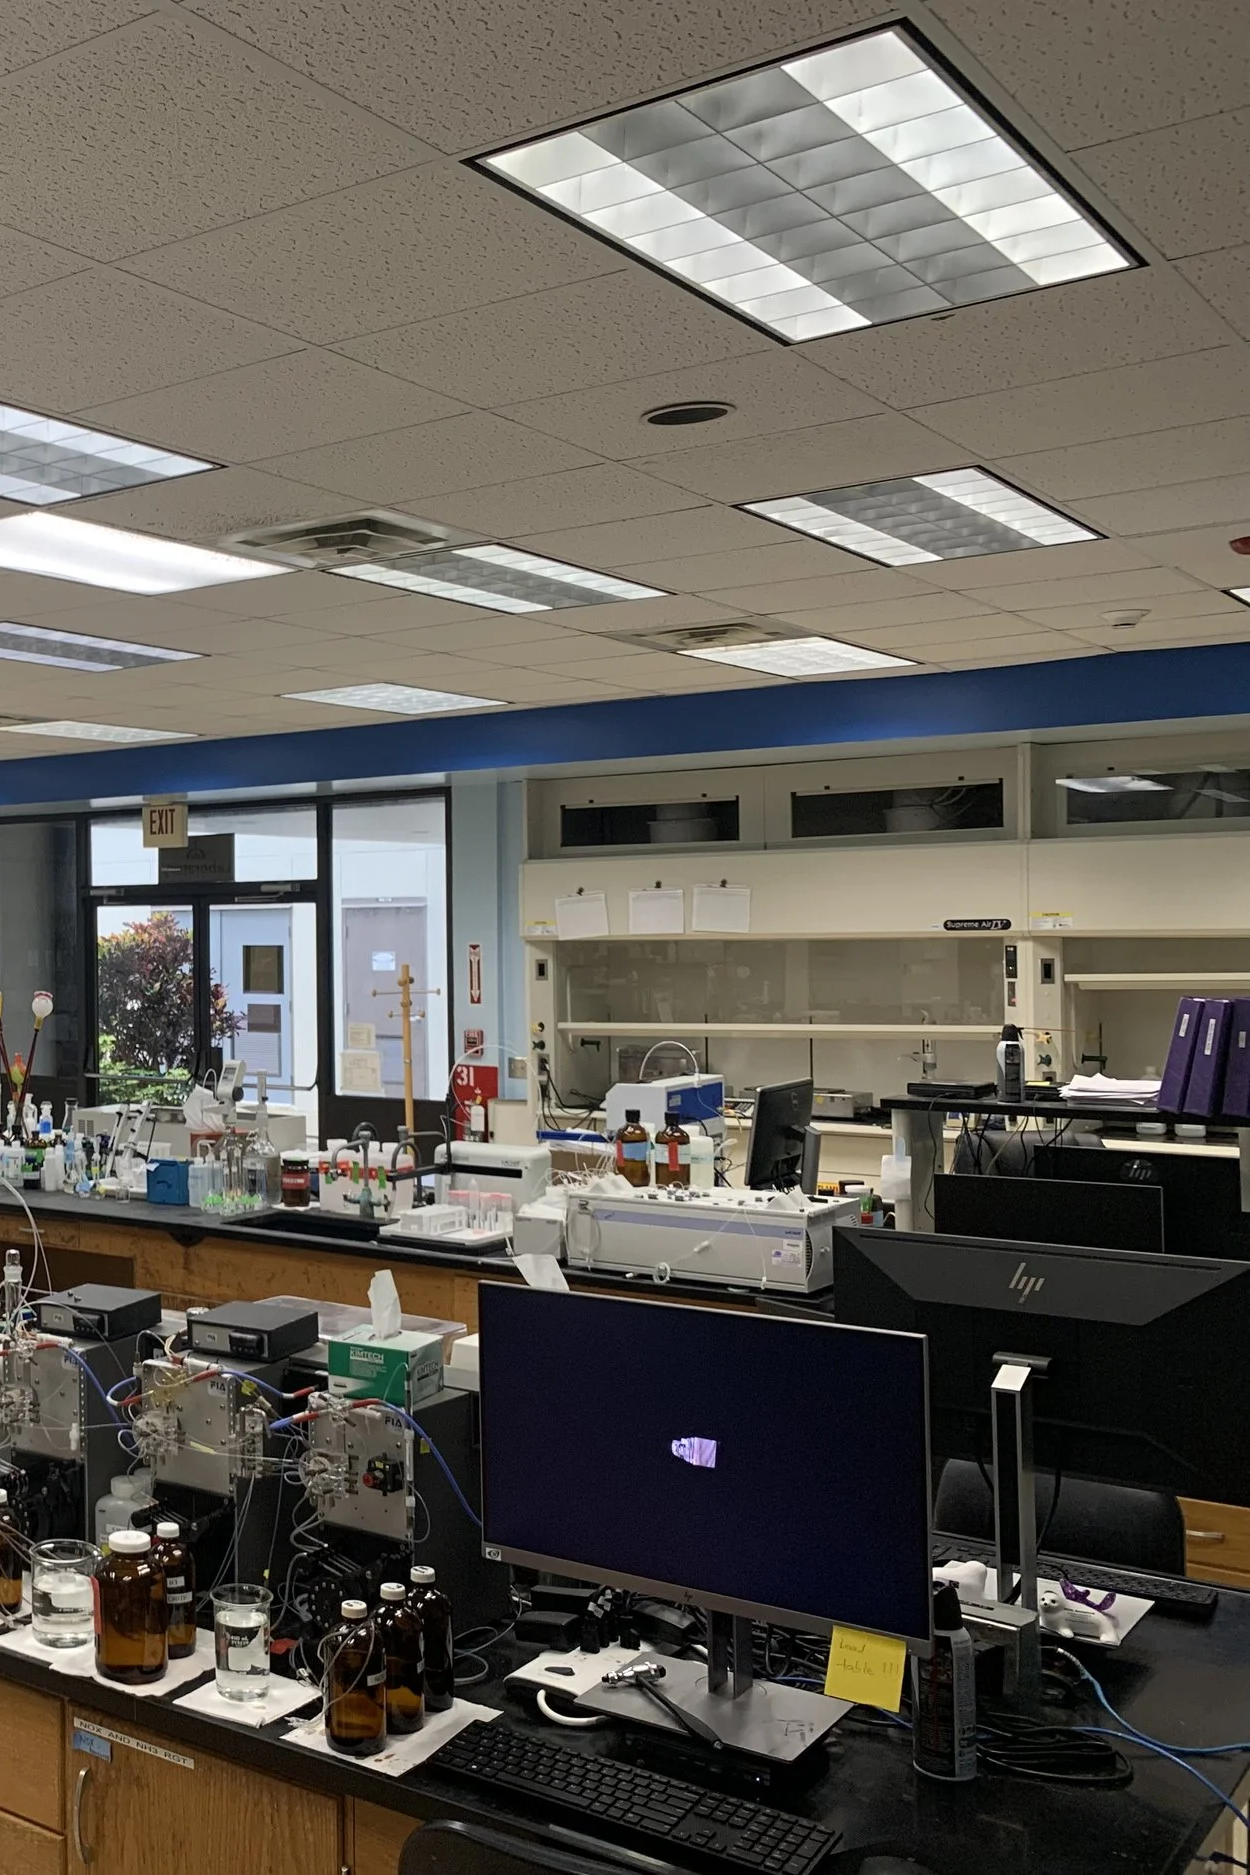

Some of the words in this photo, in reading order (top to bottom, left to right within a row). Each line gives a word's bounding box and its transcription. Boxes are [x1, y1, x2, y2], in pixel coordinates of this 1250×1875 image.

[150, 808, 176, 835] EXIT
[946, 921, 979, 929] Supreme
[456, 1065, 475, 1088] 31
[1008, 1262, 1045, 1304] hp
[350, 1350, 384, 1362] KIMTECH
[210, 1382, 226, 1393] FIA
[385, 1416, 403, 1428] FIA
[836, 1658, 875, 1676] table
[79, 1719, 102, 1734] NOX
[108, 1731, 131, 1745] AND
[136, 1741, 159, 1755] NH3
[164, 1750, 188, 1765] RGT
